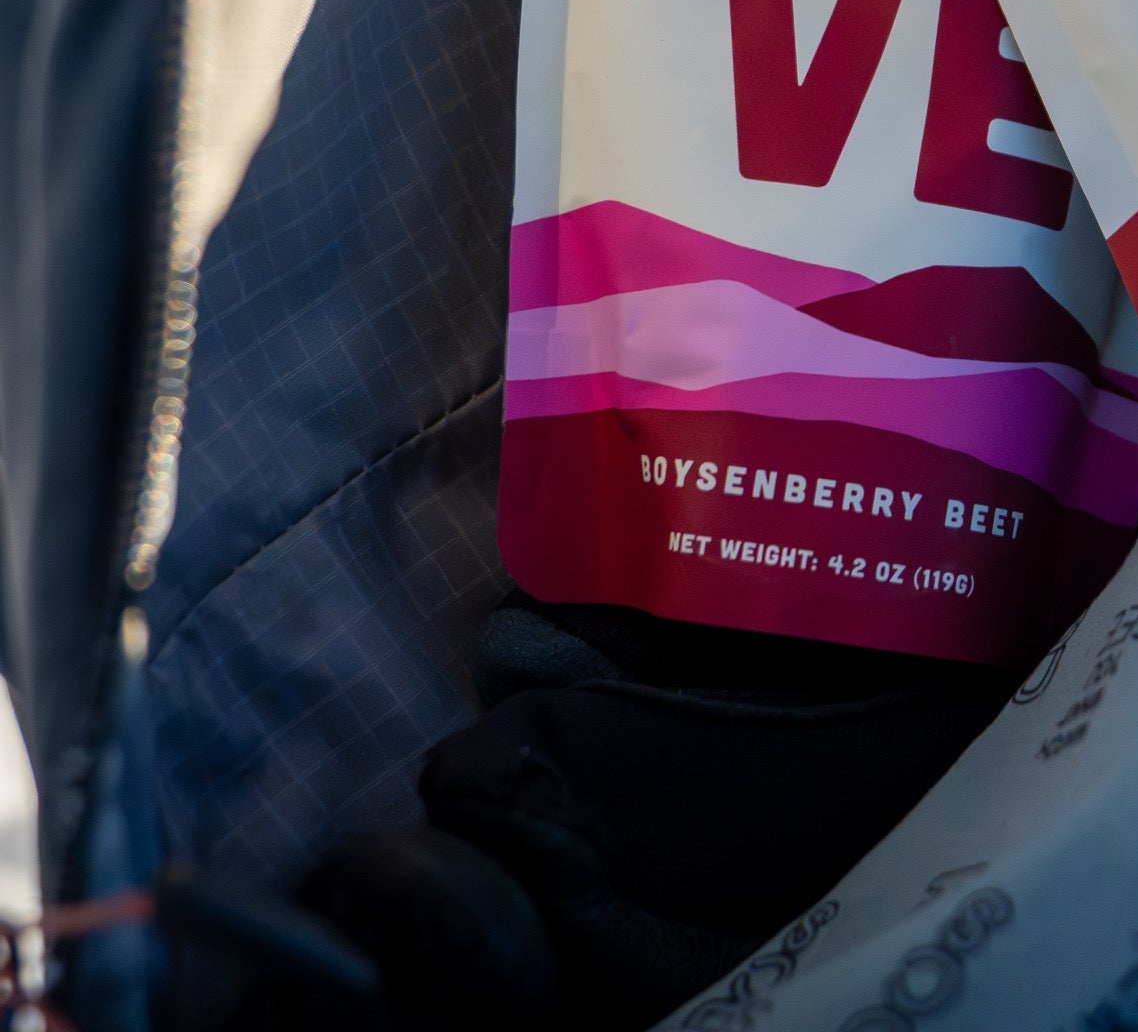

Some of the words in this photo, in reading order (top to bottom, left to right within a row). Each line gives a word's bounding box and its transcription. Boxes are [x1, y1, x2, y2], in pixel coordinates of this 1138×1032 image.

[641, 454, 923, 521] BOYSENBERRY
[944, 498, 1024, 539] BEET
[669, 531, 711, 555] NET
[720, 537, 818, 571] WEIGHT:
[828, 554, 865, 578] 4.2
[875, 560, 906, 584] OZ
[913, 566, 976, 598] (119G)
